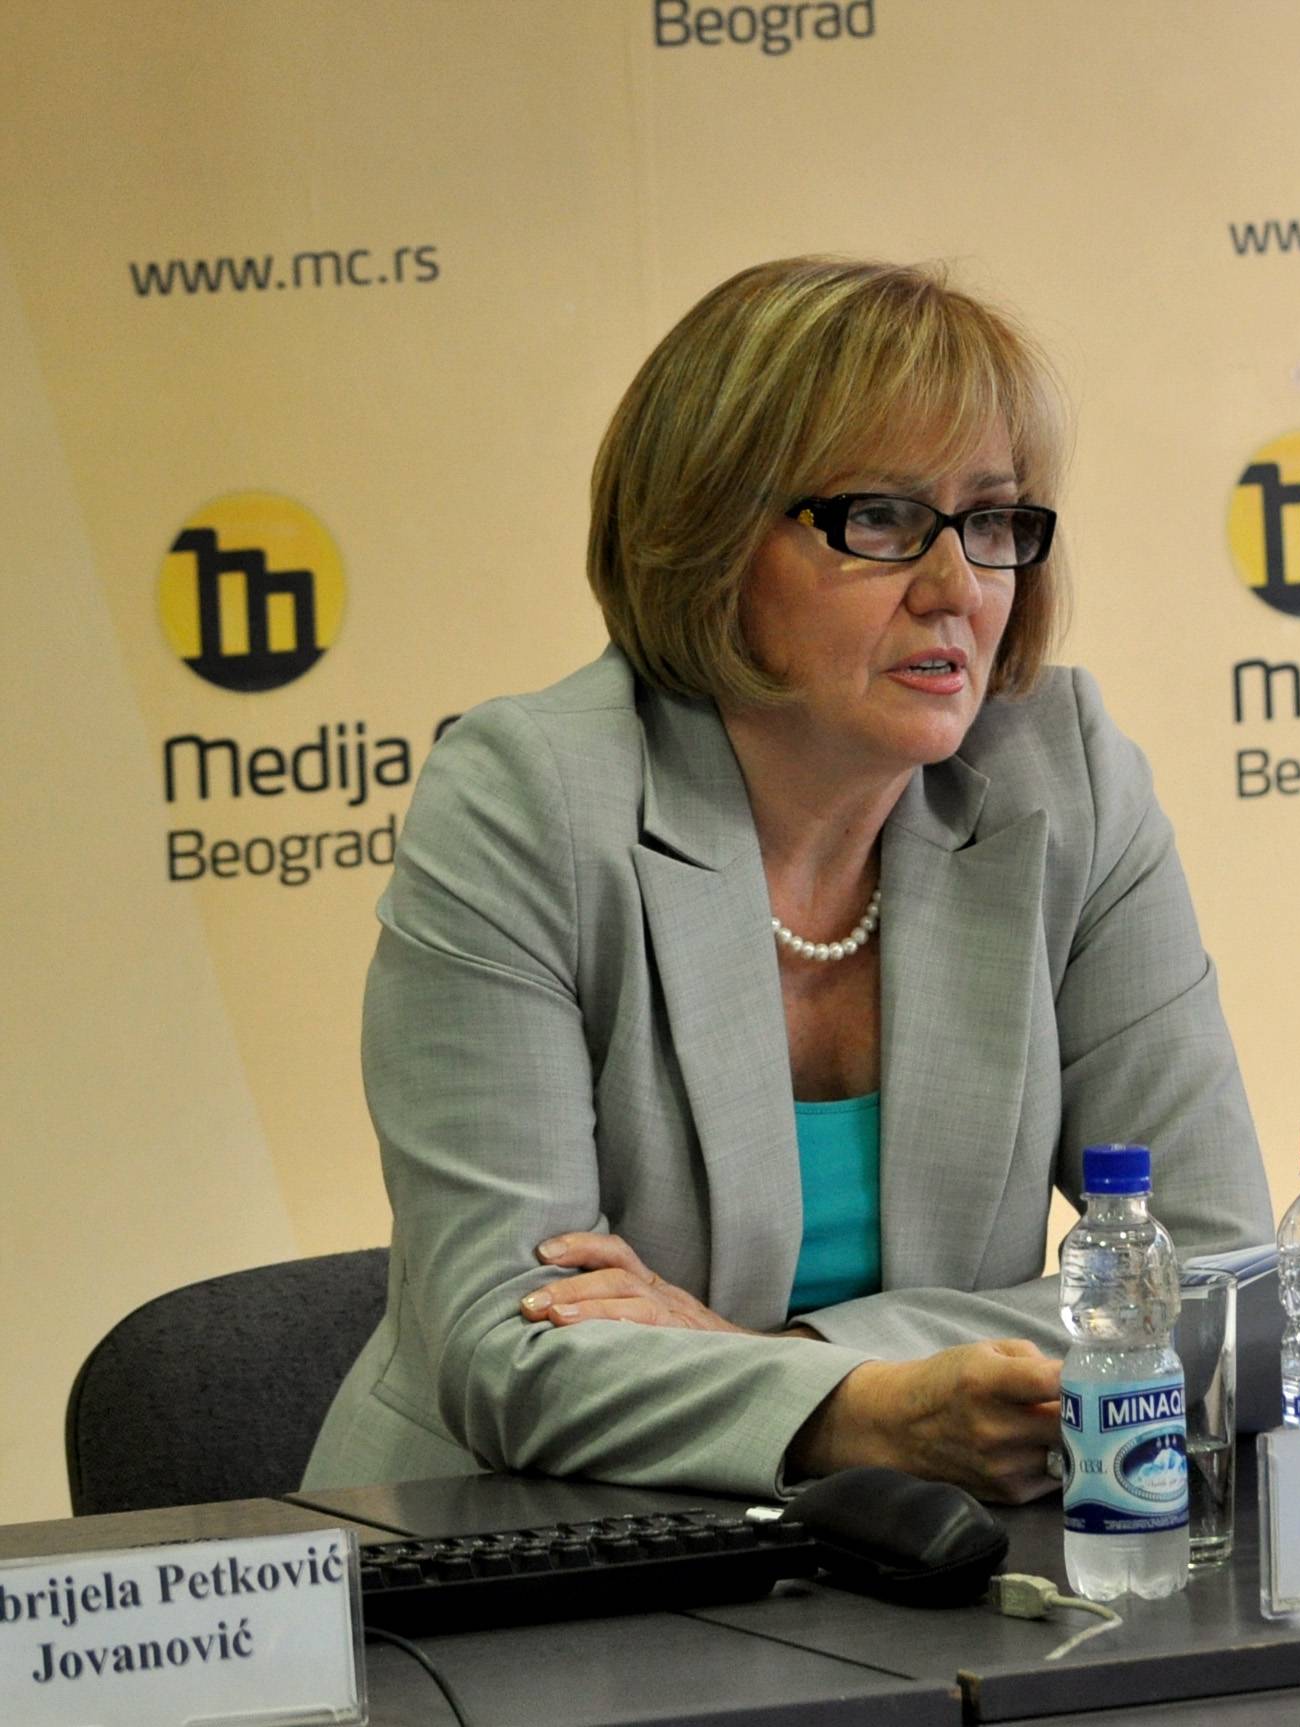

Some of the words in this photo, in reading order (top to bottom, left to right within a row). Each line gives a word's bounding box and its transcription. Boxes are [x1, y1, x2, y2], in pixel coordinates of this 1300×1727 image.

[654, 0, 876, 56] Beograd
[129, 244, 441, 298] www.mc.rs
[162, 720, 412, 808] Medija
[166, 812, 396, 888] Beograd
[156, 1543, 345, 1603] Petković
[31, 1618, 255, 1684] Jovanović
